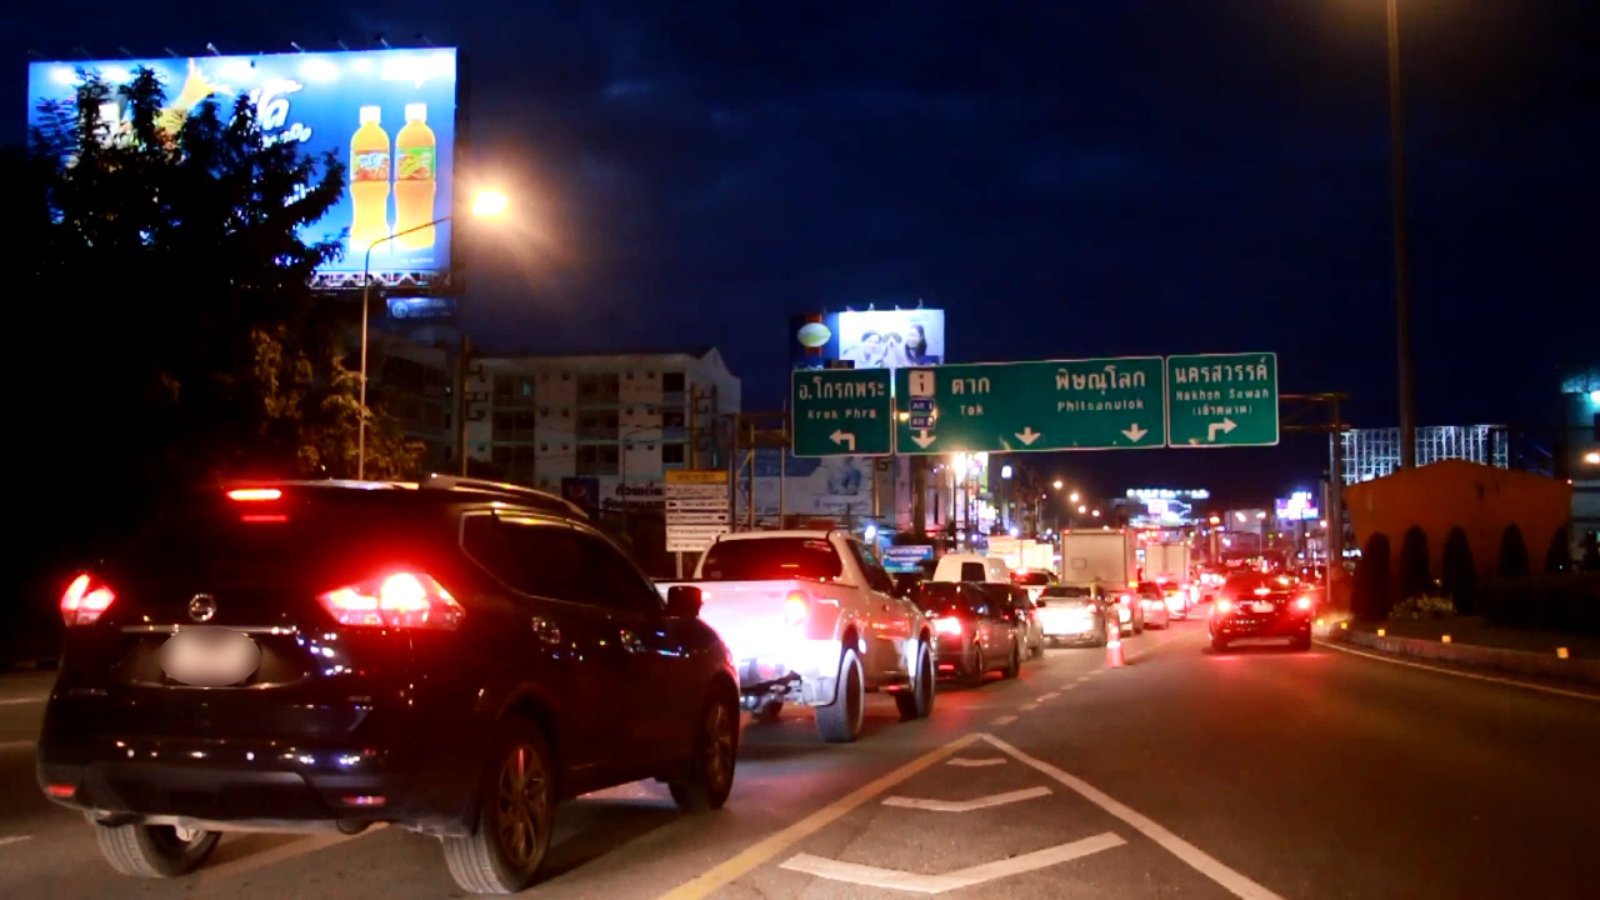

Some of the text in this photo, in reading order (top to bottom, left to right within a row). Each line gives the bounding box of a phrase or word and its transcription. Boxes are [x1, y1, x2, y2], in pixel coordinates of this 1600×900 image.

[1174, 356, 1268, 383] นครสวรรค์
[952, 377, 991, 395] ตาก
[1055, 364, 1146, 396] พิษณุโลก
[1176, 388, 1270, 401] Nakhon Sawan
[845, 408, 877, 419] Phra
[960, 402, 984, 415] Tak
